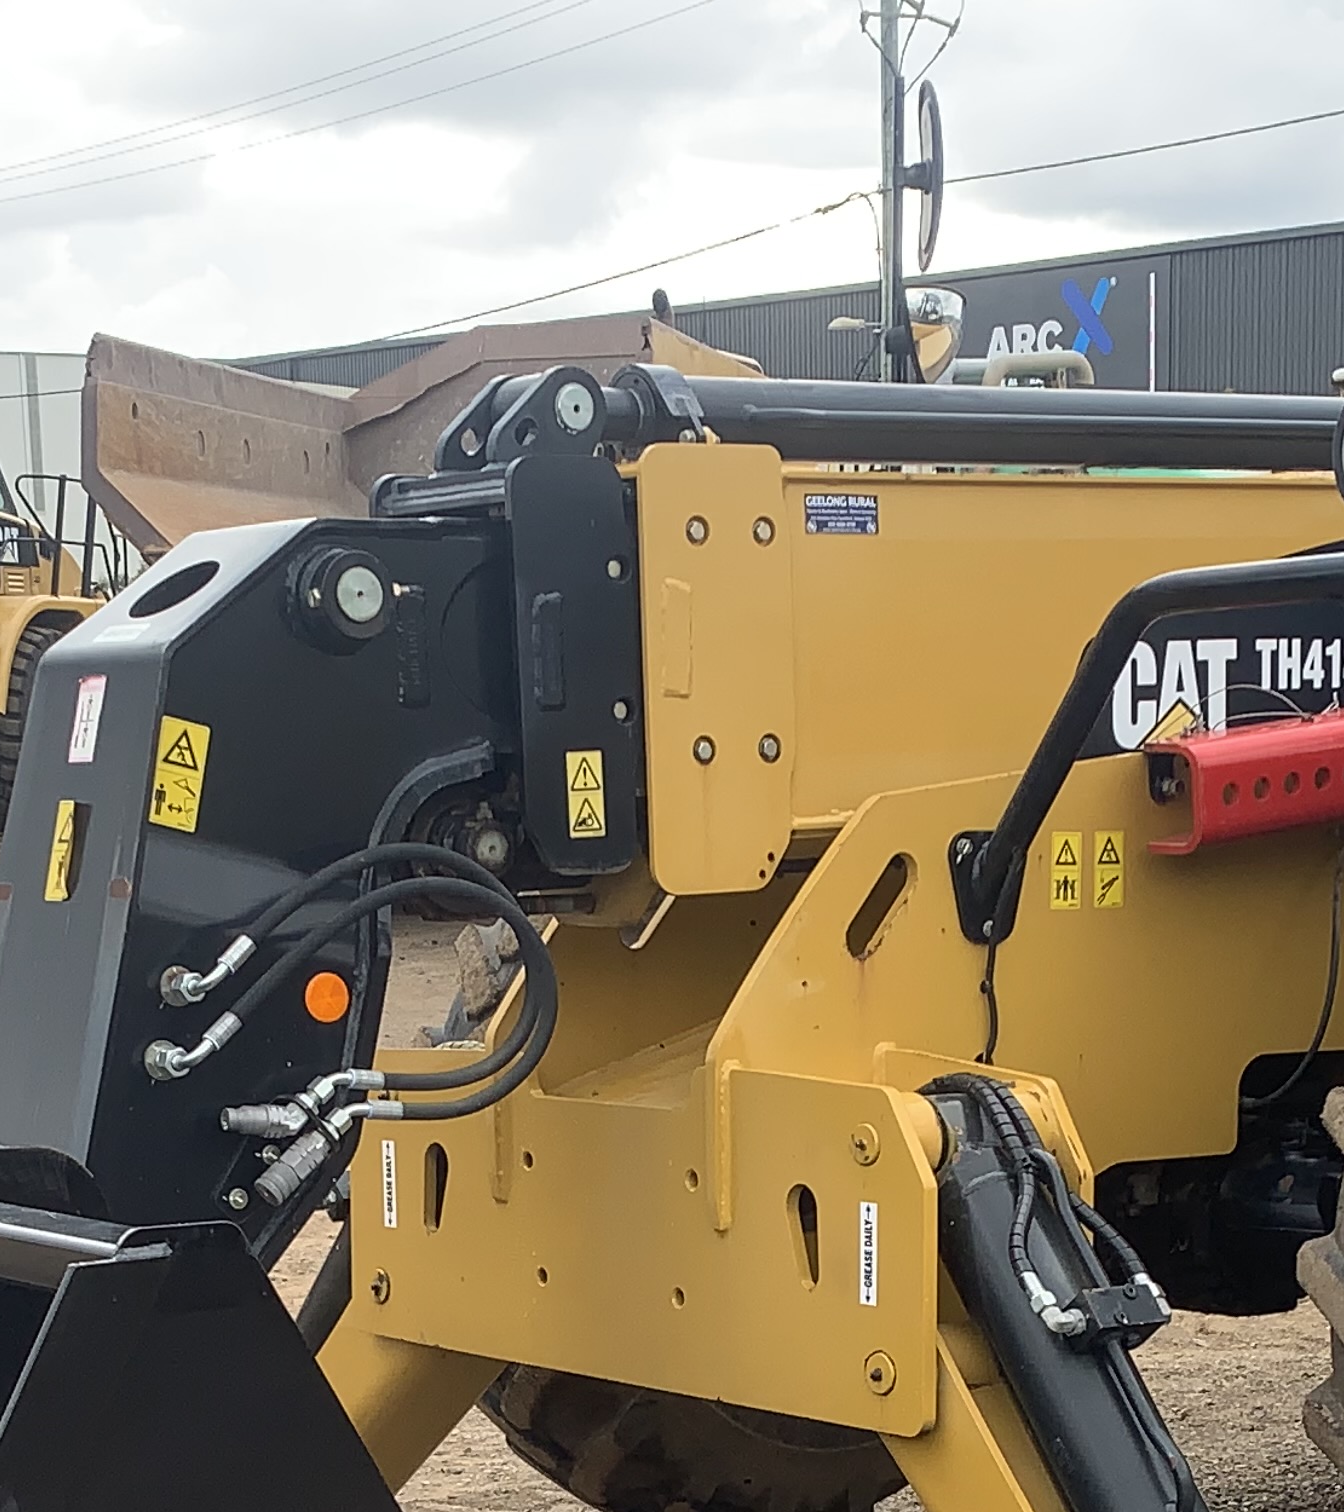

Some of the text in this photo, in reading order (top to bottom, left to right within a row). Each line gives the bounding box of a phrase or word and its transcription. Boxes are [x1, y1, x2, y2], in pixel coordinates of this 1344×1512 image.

[987, 319, 1064, 359] ARC
[805, 495, 877, 508] GEELONG RURAL
[1112, 638, 1238, 750] CAT
[385, 1180, 394, 1213] GREASE
[863, 1218, 874, 1288] GREASE DAILY
